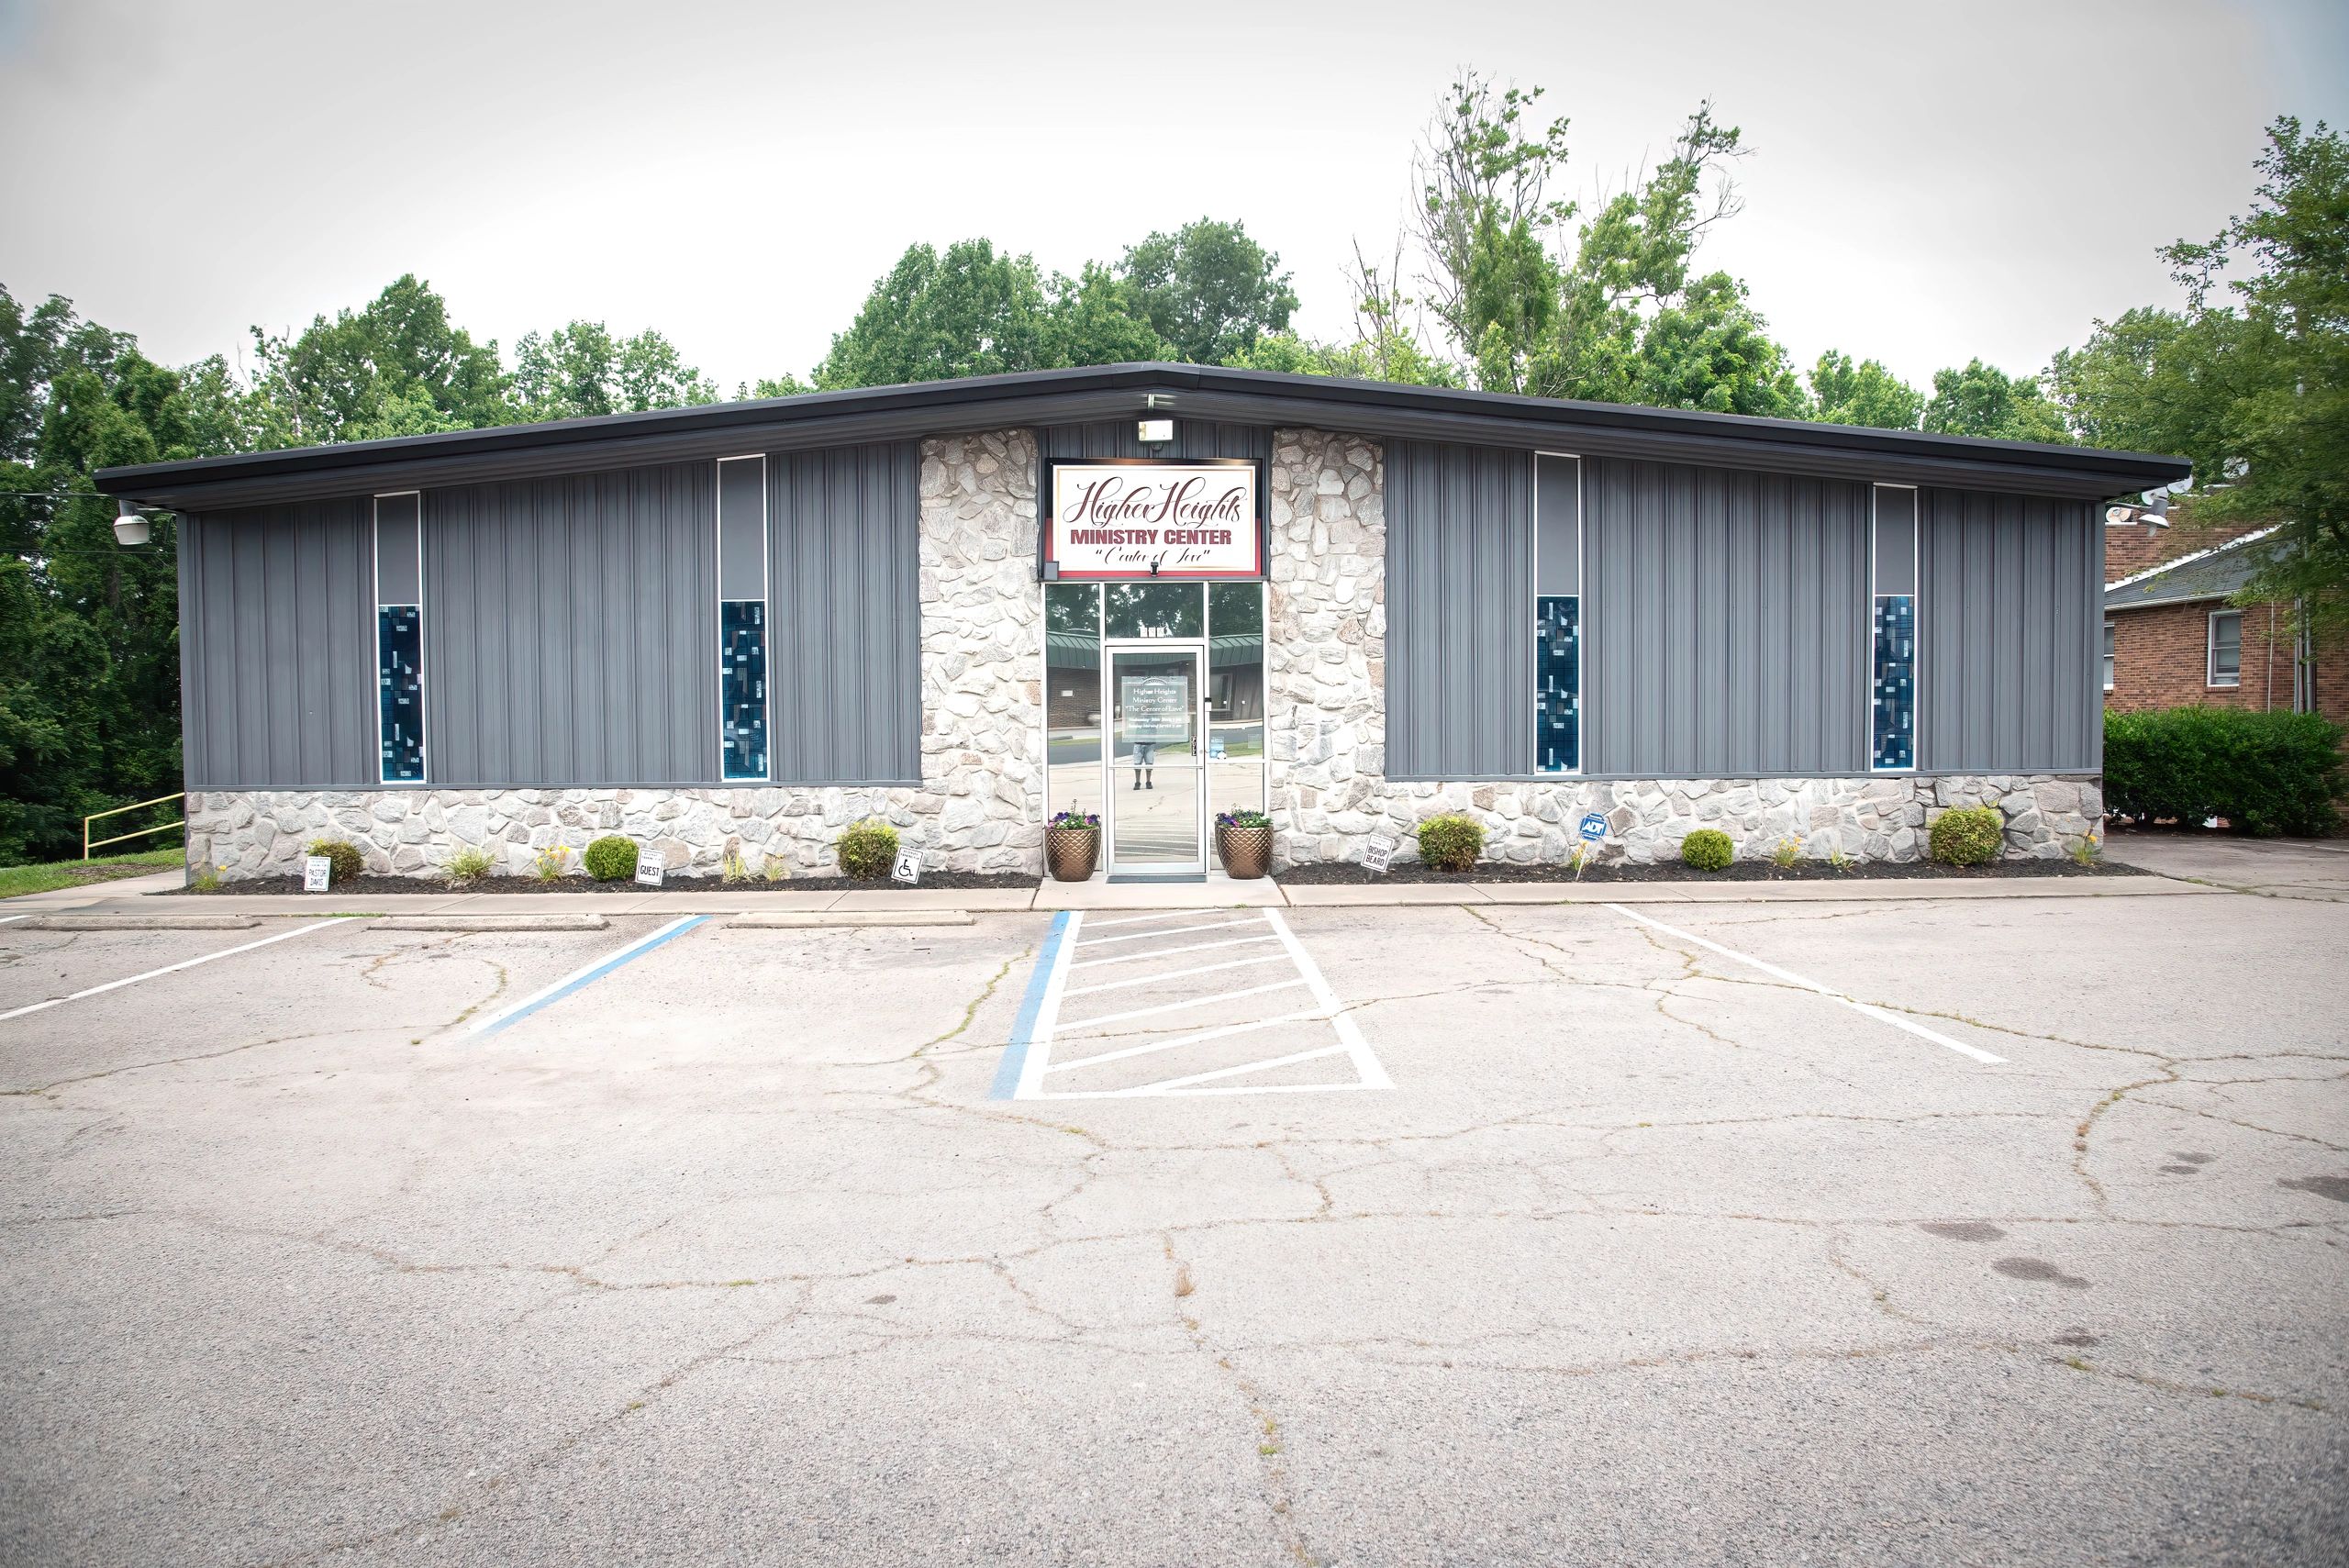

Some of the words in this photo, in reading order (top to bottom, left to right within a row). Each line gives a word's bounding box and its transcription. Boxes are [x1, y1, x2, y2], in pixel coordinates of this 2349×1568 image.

[1063, 476, 1153, 528] Higher
[1146, 476, 1248, 528] Heights
[1070, 529, 1158, 545] MINISTRY
[1163, 529, 1231, 545] CENTER
[1581, 820, 1604, 834] ADT
[1367, 845, 1388, 857] BISHOP
[1365, 854, 1385, 866] BEARD
[308, 869, 327, 877] PASTOR
[640, 865, 660, 876] GUEST
